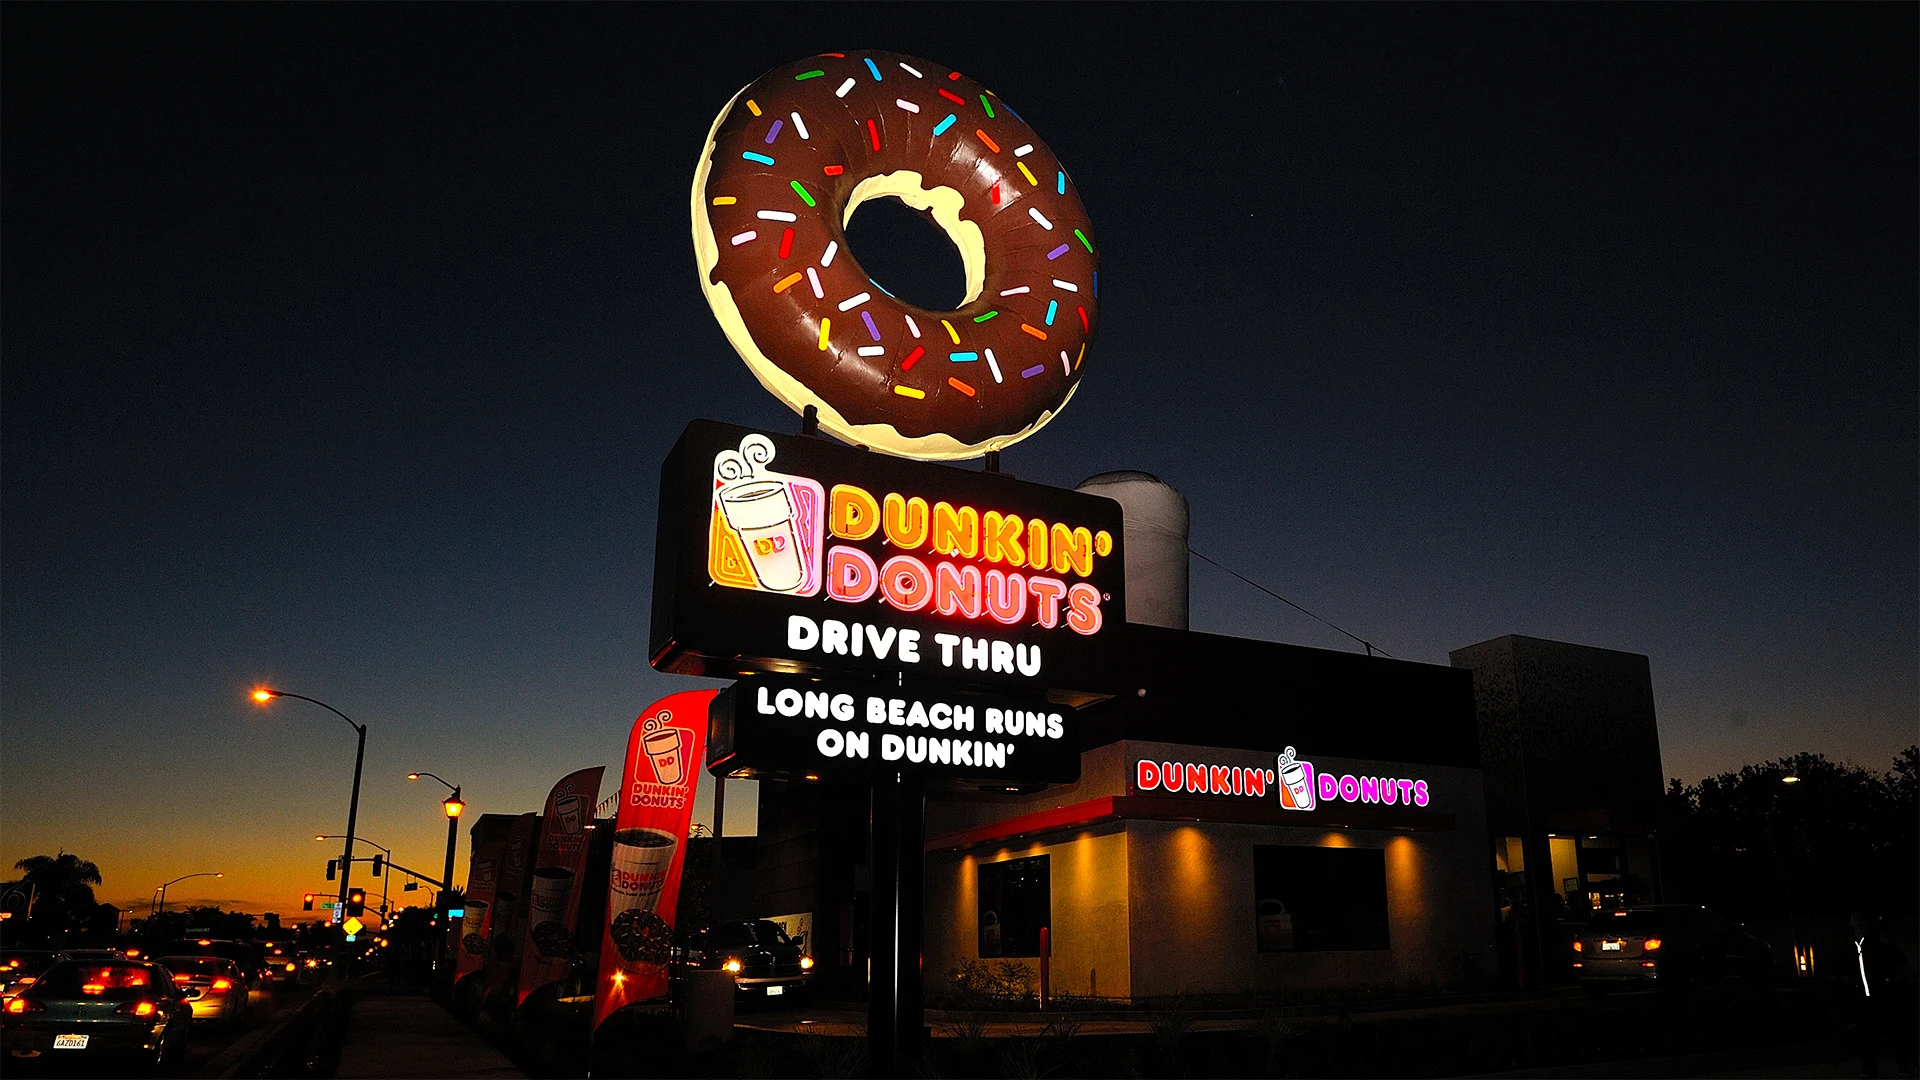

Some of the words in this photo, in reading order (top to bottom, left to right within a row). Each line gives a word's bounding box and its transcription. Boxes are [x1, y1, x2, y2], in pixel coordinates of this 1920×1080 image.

[754, 535, 786, 555] DD
[829, 484, 1112, 577] DUNKIN'
[827, 545, 1102, 635] DONUTS
[788, 615, 921, 663] DRIVE
[935, 633, 1041, 676] THRU
[757, 687, 854, 721] LONG
[867, 697, 974, 731] BEACH
[986, 708, 1063, 739] RUNS
[658, 756, 675, 767] DD
[817, 729, 869, 759] ON
[882, 734, 1014, 768] DUNKIN'
[633, 783, 689, 797] DUNKIN'
[1137, 759, 1275, 797] DUNKIN'
[1318, 773, 1430, 808] DONUTS
[631, 794, 684, 809] DONUTS
